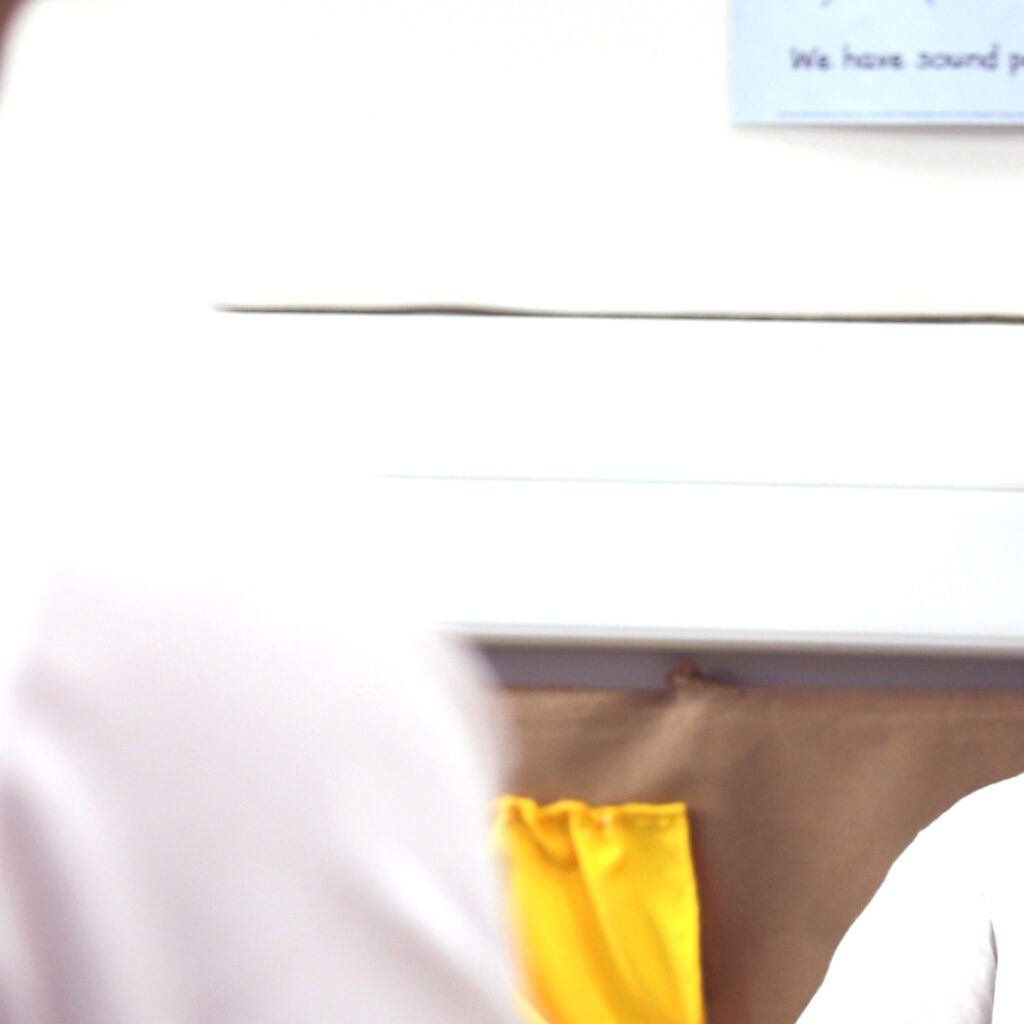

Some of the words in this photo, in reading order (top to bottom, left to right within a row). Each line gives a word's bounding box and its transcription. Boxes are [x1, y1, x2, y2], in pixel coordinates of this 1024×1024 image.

[790, 47, 831, 71] We
[842, 46, 905, 71] have
[916, 43, 1001, 72] sound
